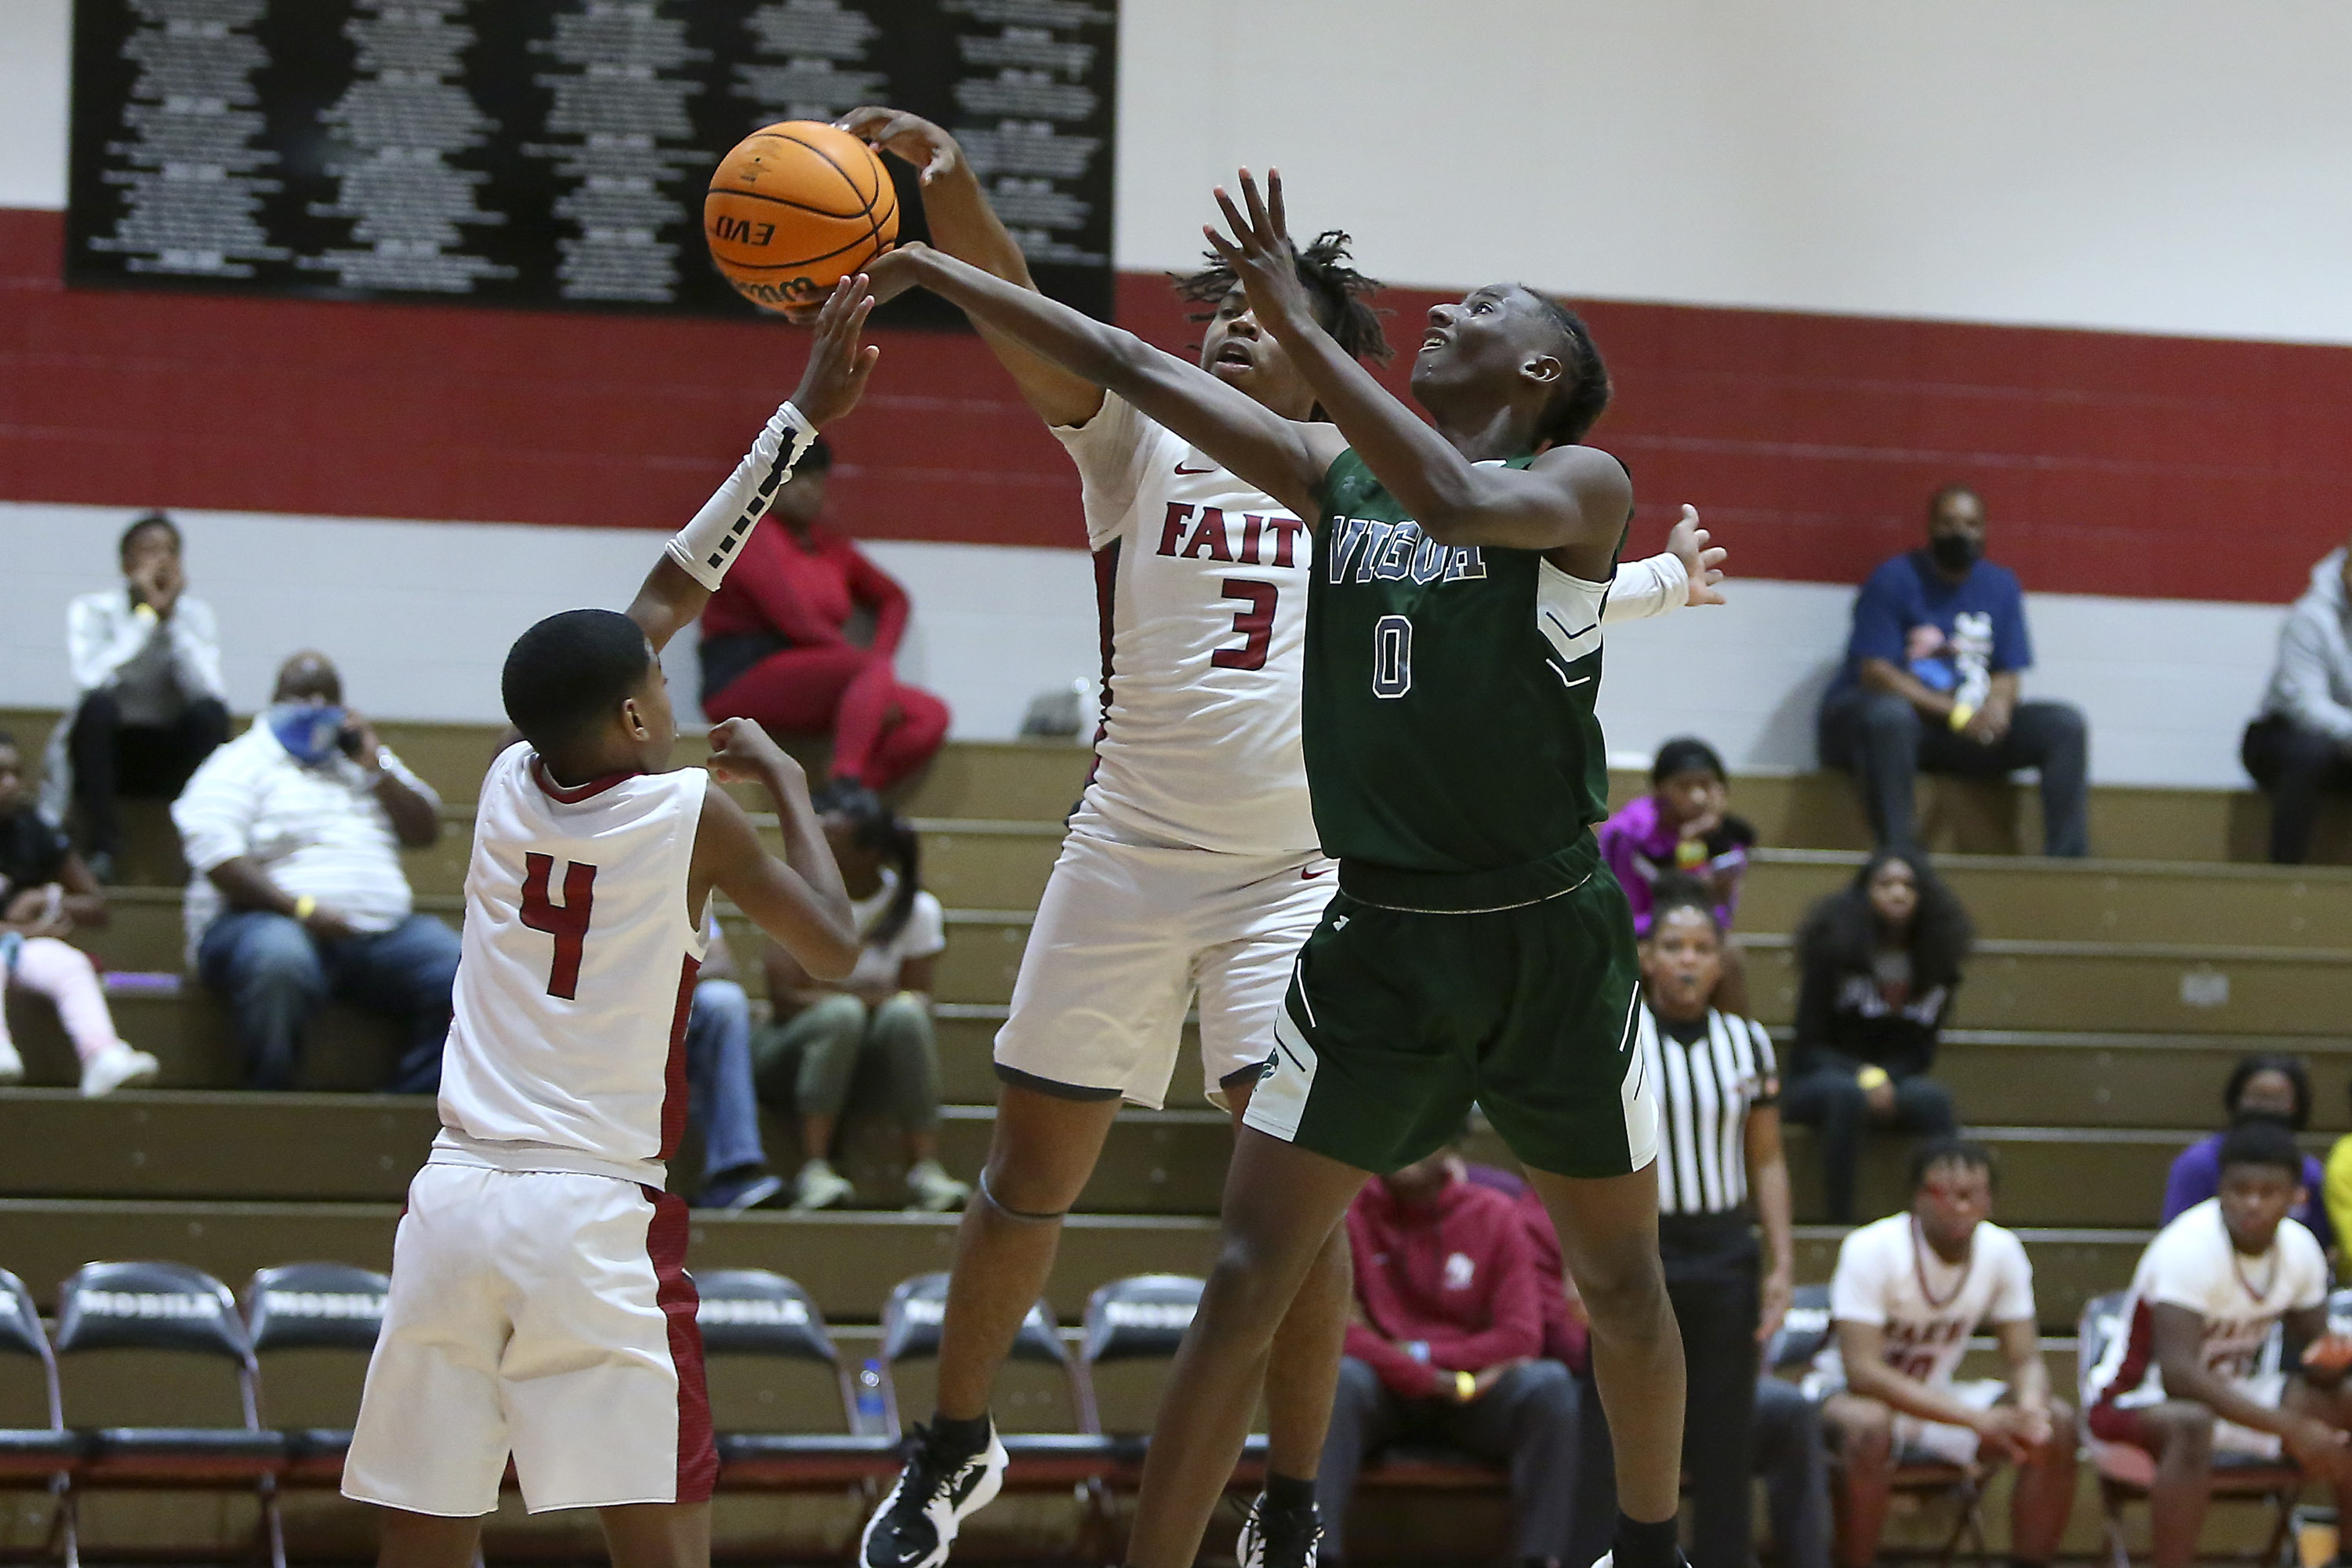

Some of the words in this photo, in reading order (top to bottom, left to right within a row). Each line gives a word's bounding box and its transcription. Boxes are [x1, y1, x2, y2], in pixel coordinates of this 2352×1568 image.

[716, 216, 775, 247] EVO
[1156, 501, 1312, 569] FAIT
[1210, 578, 1279, 672] 3
[1372, 615, 1413, 699] 0
[519, 851, 597, 1001] 4
